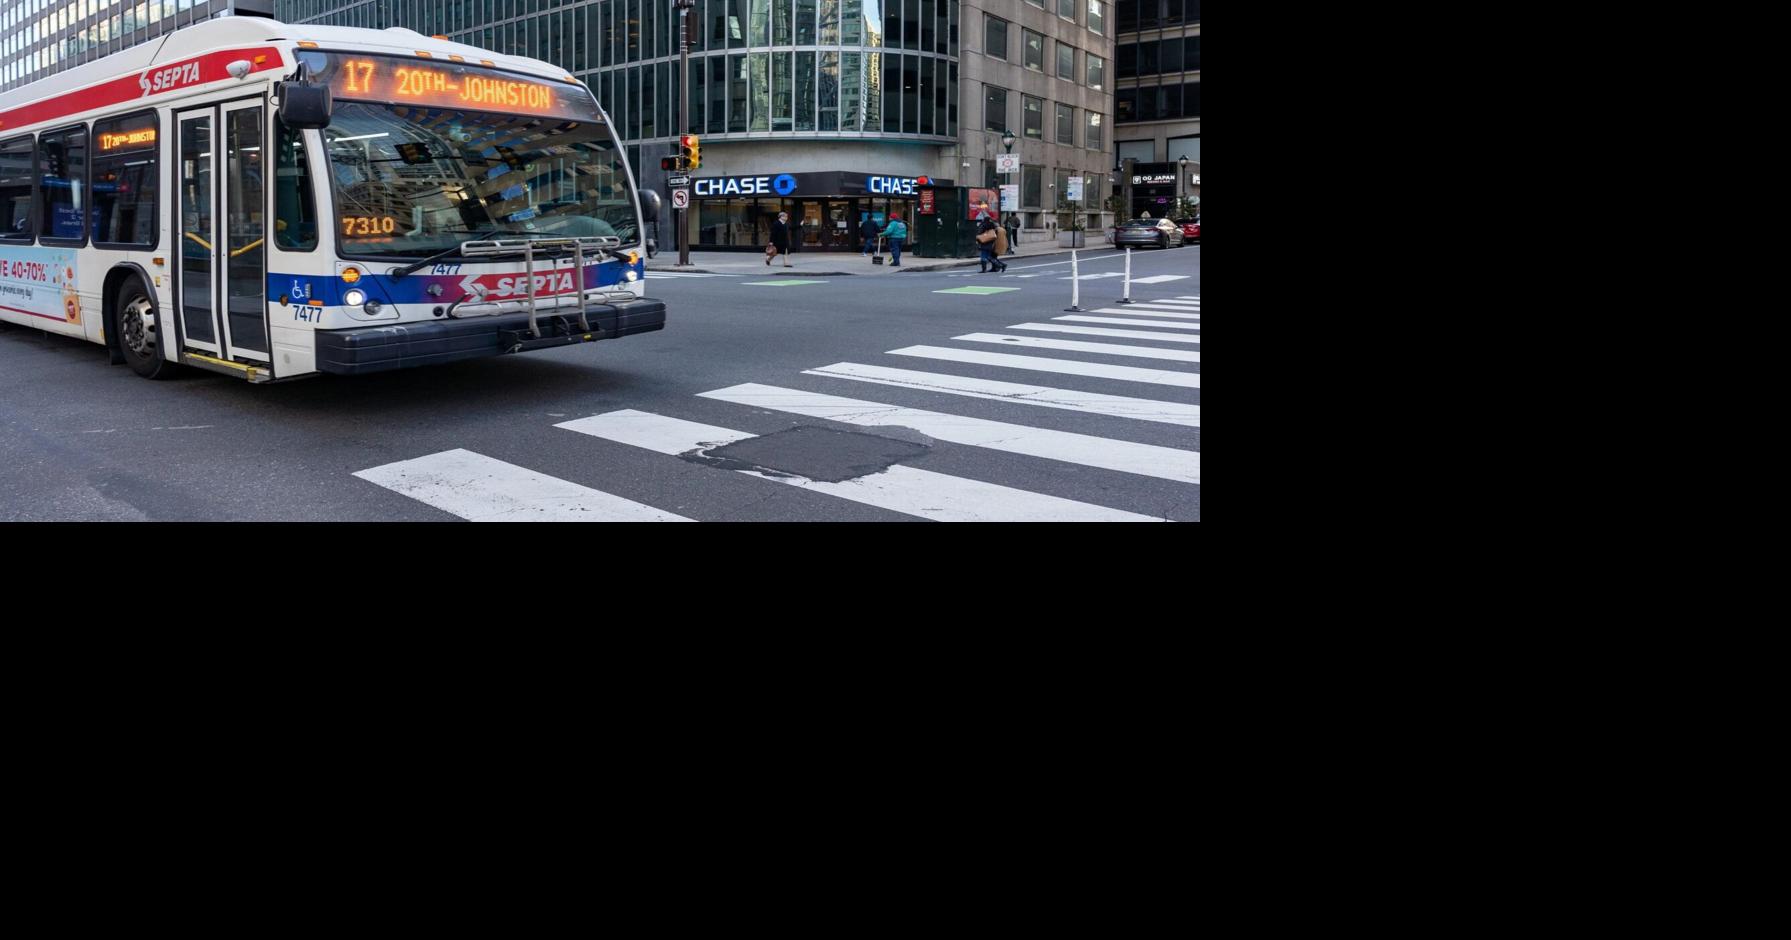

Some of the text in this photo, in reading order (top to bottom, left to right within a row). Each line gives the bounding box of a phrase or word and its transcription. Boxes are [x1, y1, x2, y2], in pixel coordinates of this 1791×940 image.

[153, 61, 200, 92] SEPTA
[345, 61, 552, 109] 17 20TH-JOHNSTON
[103, 135, 112, 150] 17
[694, 176, 770, 196] CHASE
[343, 217, 394, 236] 7310
[431, 263, 462, 275] 7477
[496, 272, 574, 297] SEPTA
[293, 305, 323, 324] 7477
